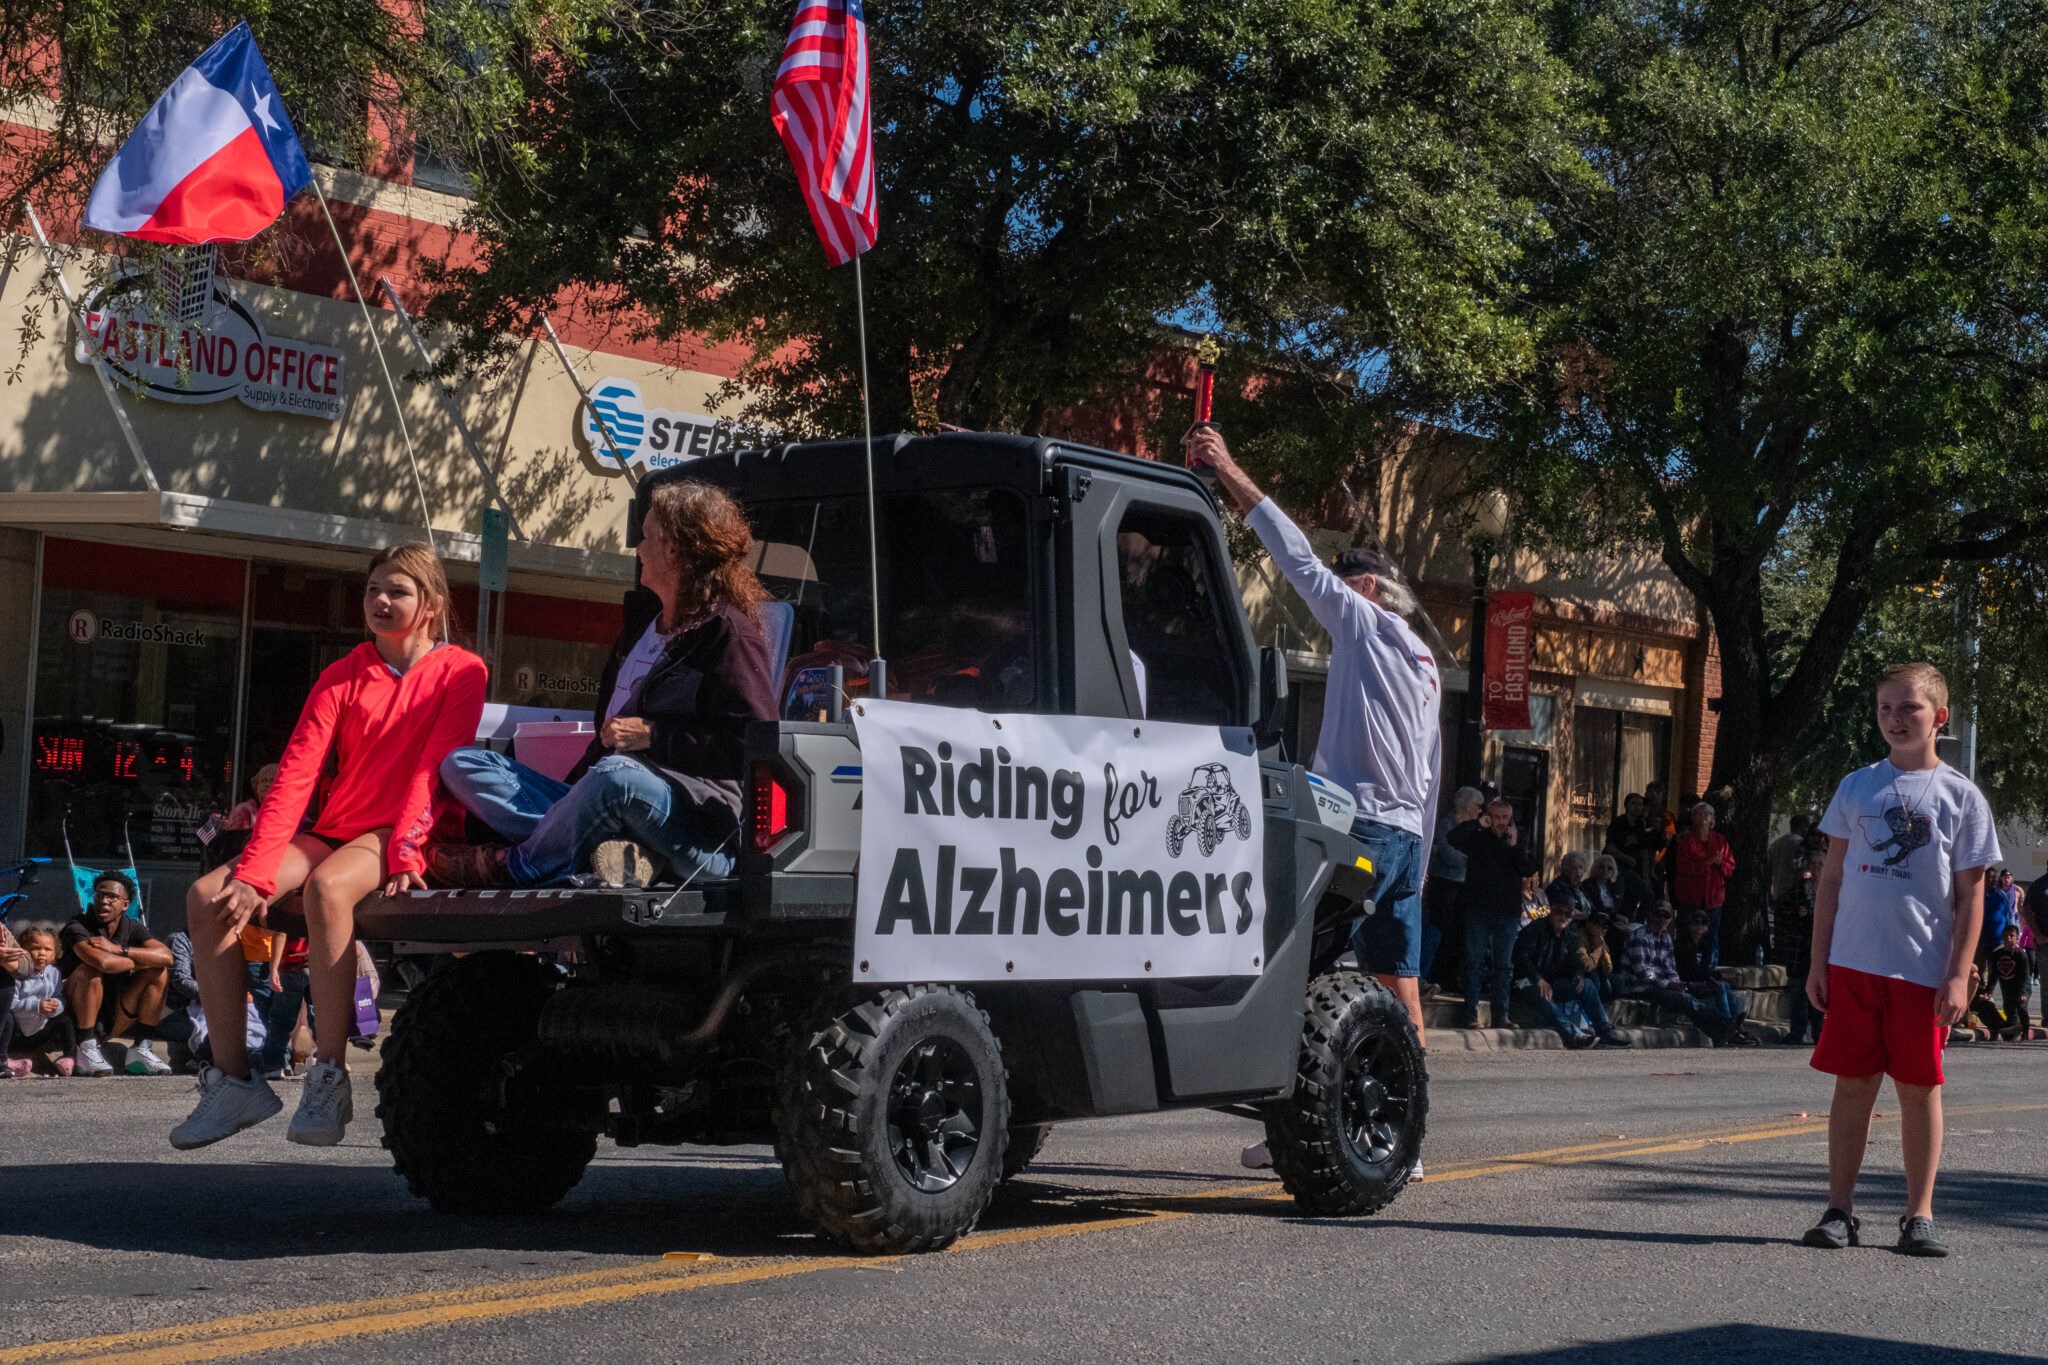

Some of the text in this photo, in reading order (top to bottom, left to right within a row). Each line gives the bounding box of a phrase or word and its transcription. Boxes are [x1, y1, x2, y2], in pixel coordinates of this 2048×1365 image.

[244, 342, 339, 395] OFFICE
[244, 384, 341, 414] Supply & Electronics
[101, 619, 206, 647] RadioShack
[538, 672, 601, 695] RadioSha
[1505, 625, 1527, 702] EASTLAND
[1488, 681, 1502, 702] TO
[899, 740, 1163, 846] Riding for
[874, 844, 1254, 937] Alzheimers
